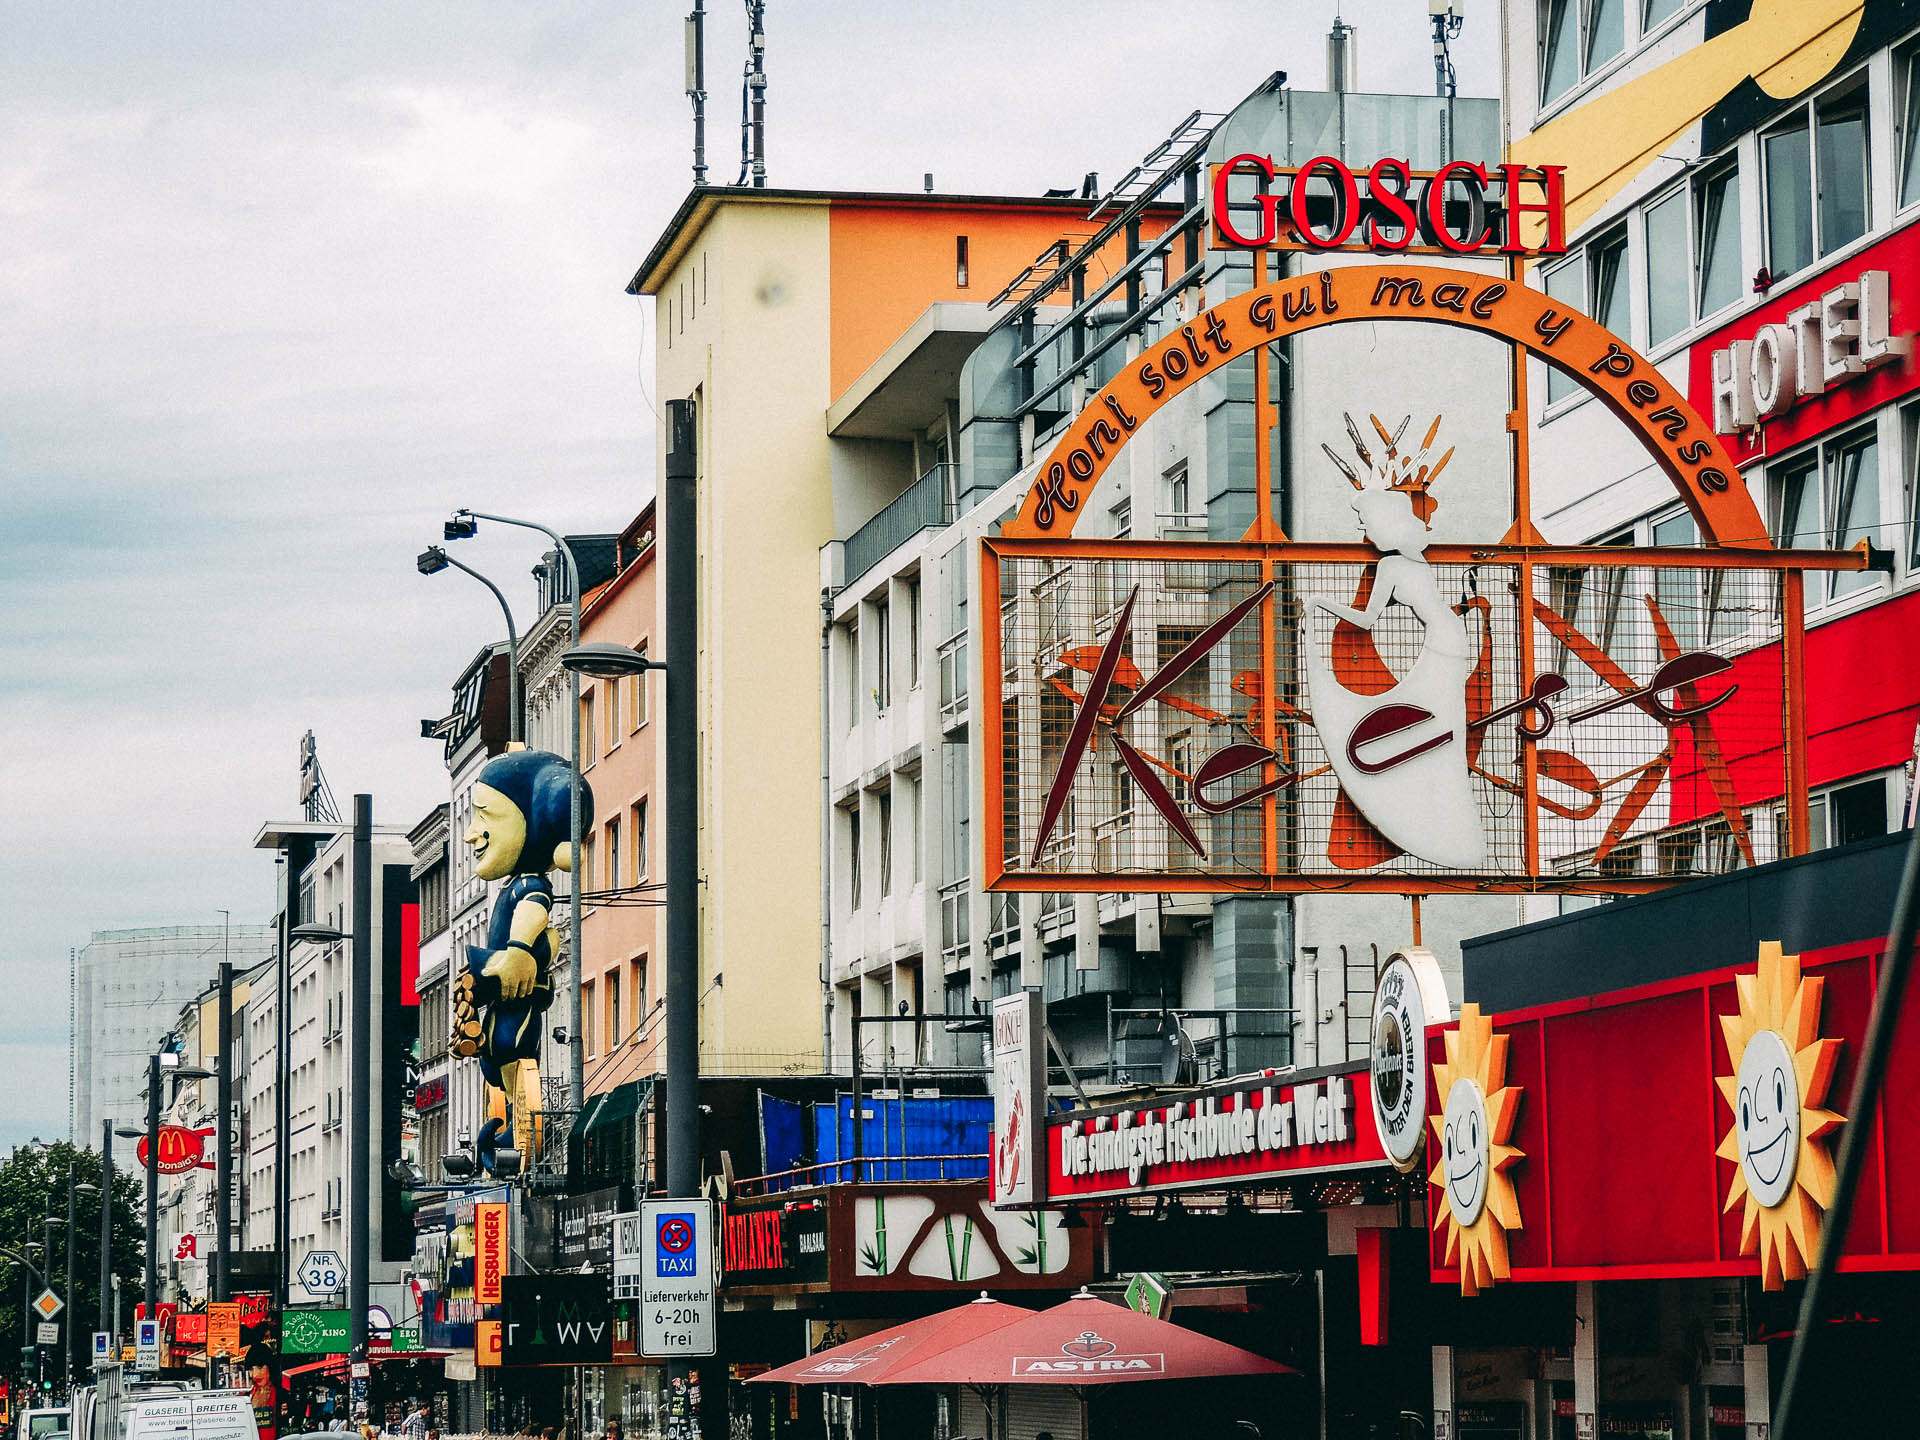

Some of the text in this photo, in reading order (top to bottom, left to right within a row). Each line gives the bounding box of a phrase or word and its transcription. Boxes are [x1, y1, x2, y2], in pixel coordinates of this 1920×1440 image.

[1213, 153, 1568, 253] GOSCH
[1711, 270, 1905, 436] HOTEL
[1034, 394, 1138, 529] Honi
[1139, 310, 1233, 398] soit
[1370, 277, 1507, 319] mal
[1534, 309, 1574, 346] y
[1588, 343, 1729, 495] pense
[996, 1009, 1023, 1049] GOSCH
[1401, 1007, 1415, 1073] BIEREN
[1402, 1079, 1414, 1117] DEN
[1062, 1076, 1352, 1186] Die sündigste Fischbude der Welt
[144, 1153, 198, 1170] Donald's
[722, 1204, 783, 1272] INDIANER
[313, 1256, 333, 1266] NR.
[482, 1209, 501, 1298] HESBURGER
[659, 1258, 693, 1272] TAXI
[309, 1270, 337, 1287] 38
[644, 1289, 709, 1303] Lieferverkehr
[655, 1308, 700, 1324] 6-20h
[322, 1328, 347, 1337] KINO
[664, 1331, 692, 1346] frei
[1026, 1359, 1151, 1372] ASTRA
[144, 1404, 238, 1416] GLASEREI BREITER
